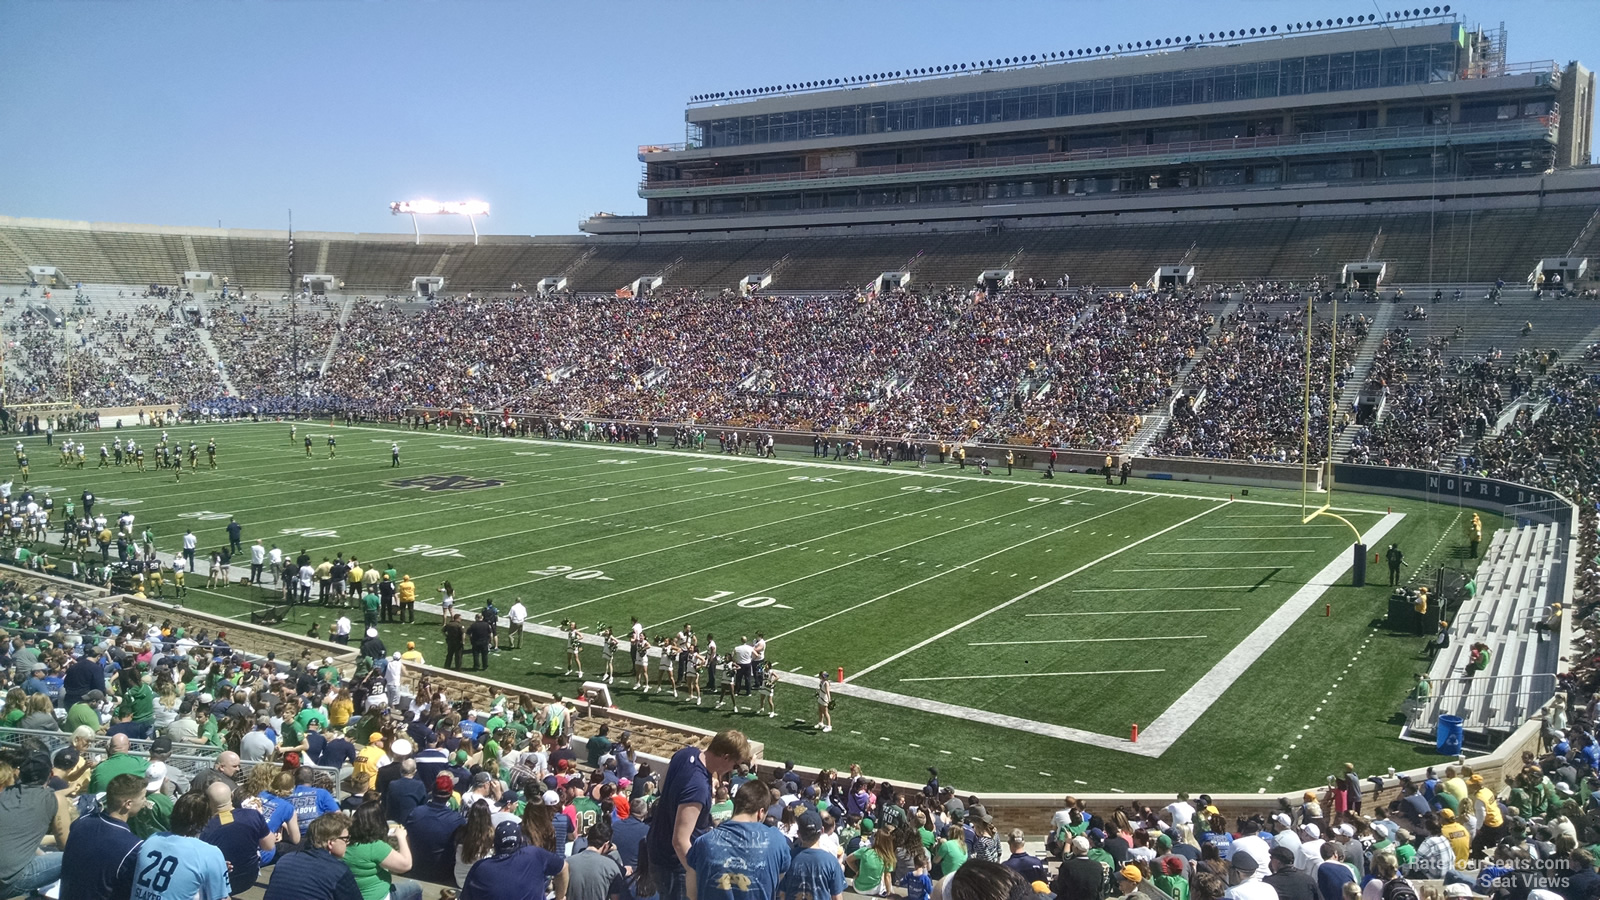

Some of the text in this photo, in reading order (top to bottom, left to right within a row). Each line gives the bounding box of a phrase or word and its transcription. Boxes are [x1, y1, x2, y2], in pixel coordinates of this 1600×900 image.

[1429, 476, 1553, 509] NOTRE DAM
[392, 544, 461, 558] 30
[527, 565, 605, 581] 20
[692, 590, 777, 609] 10
[371, 684, 384, 695] 28
[575, 809, 597, 836] 13
[137, 849, 179, 893] 28
